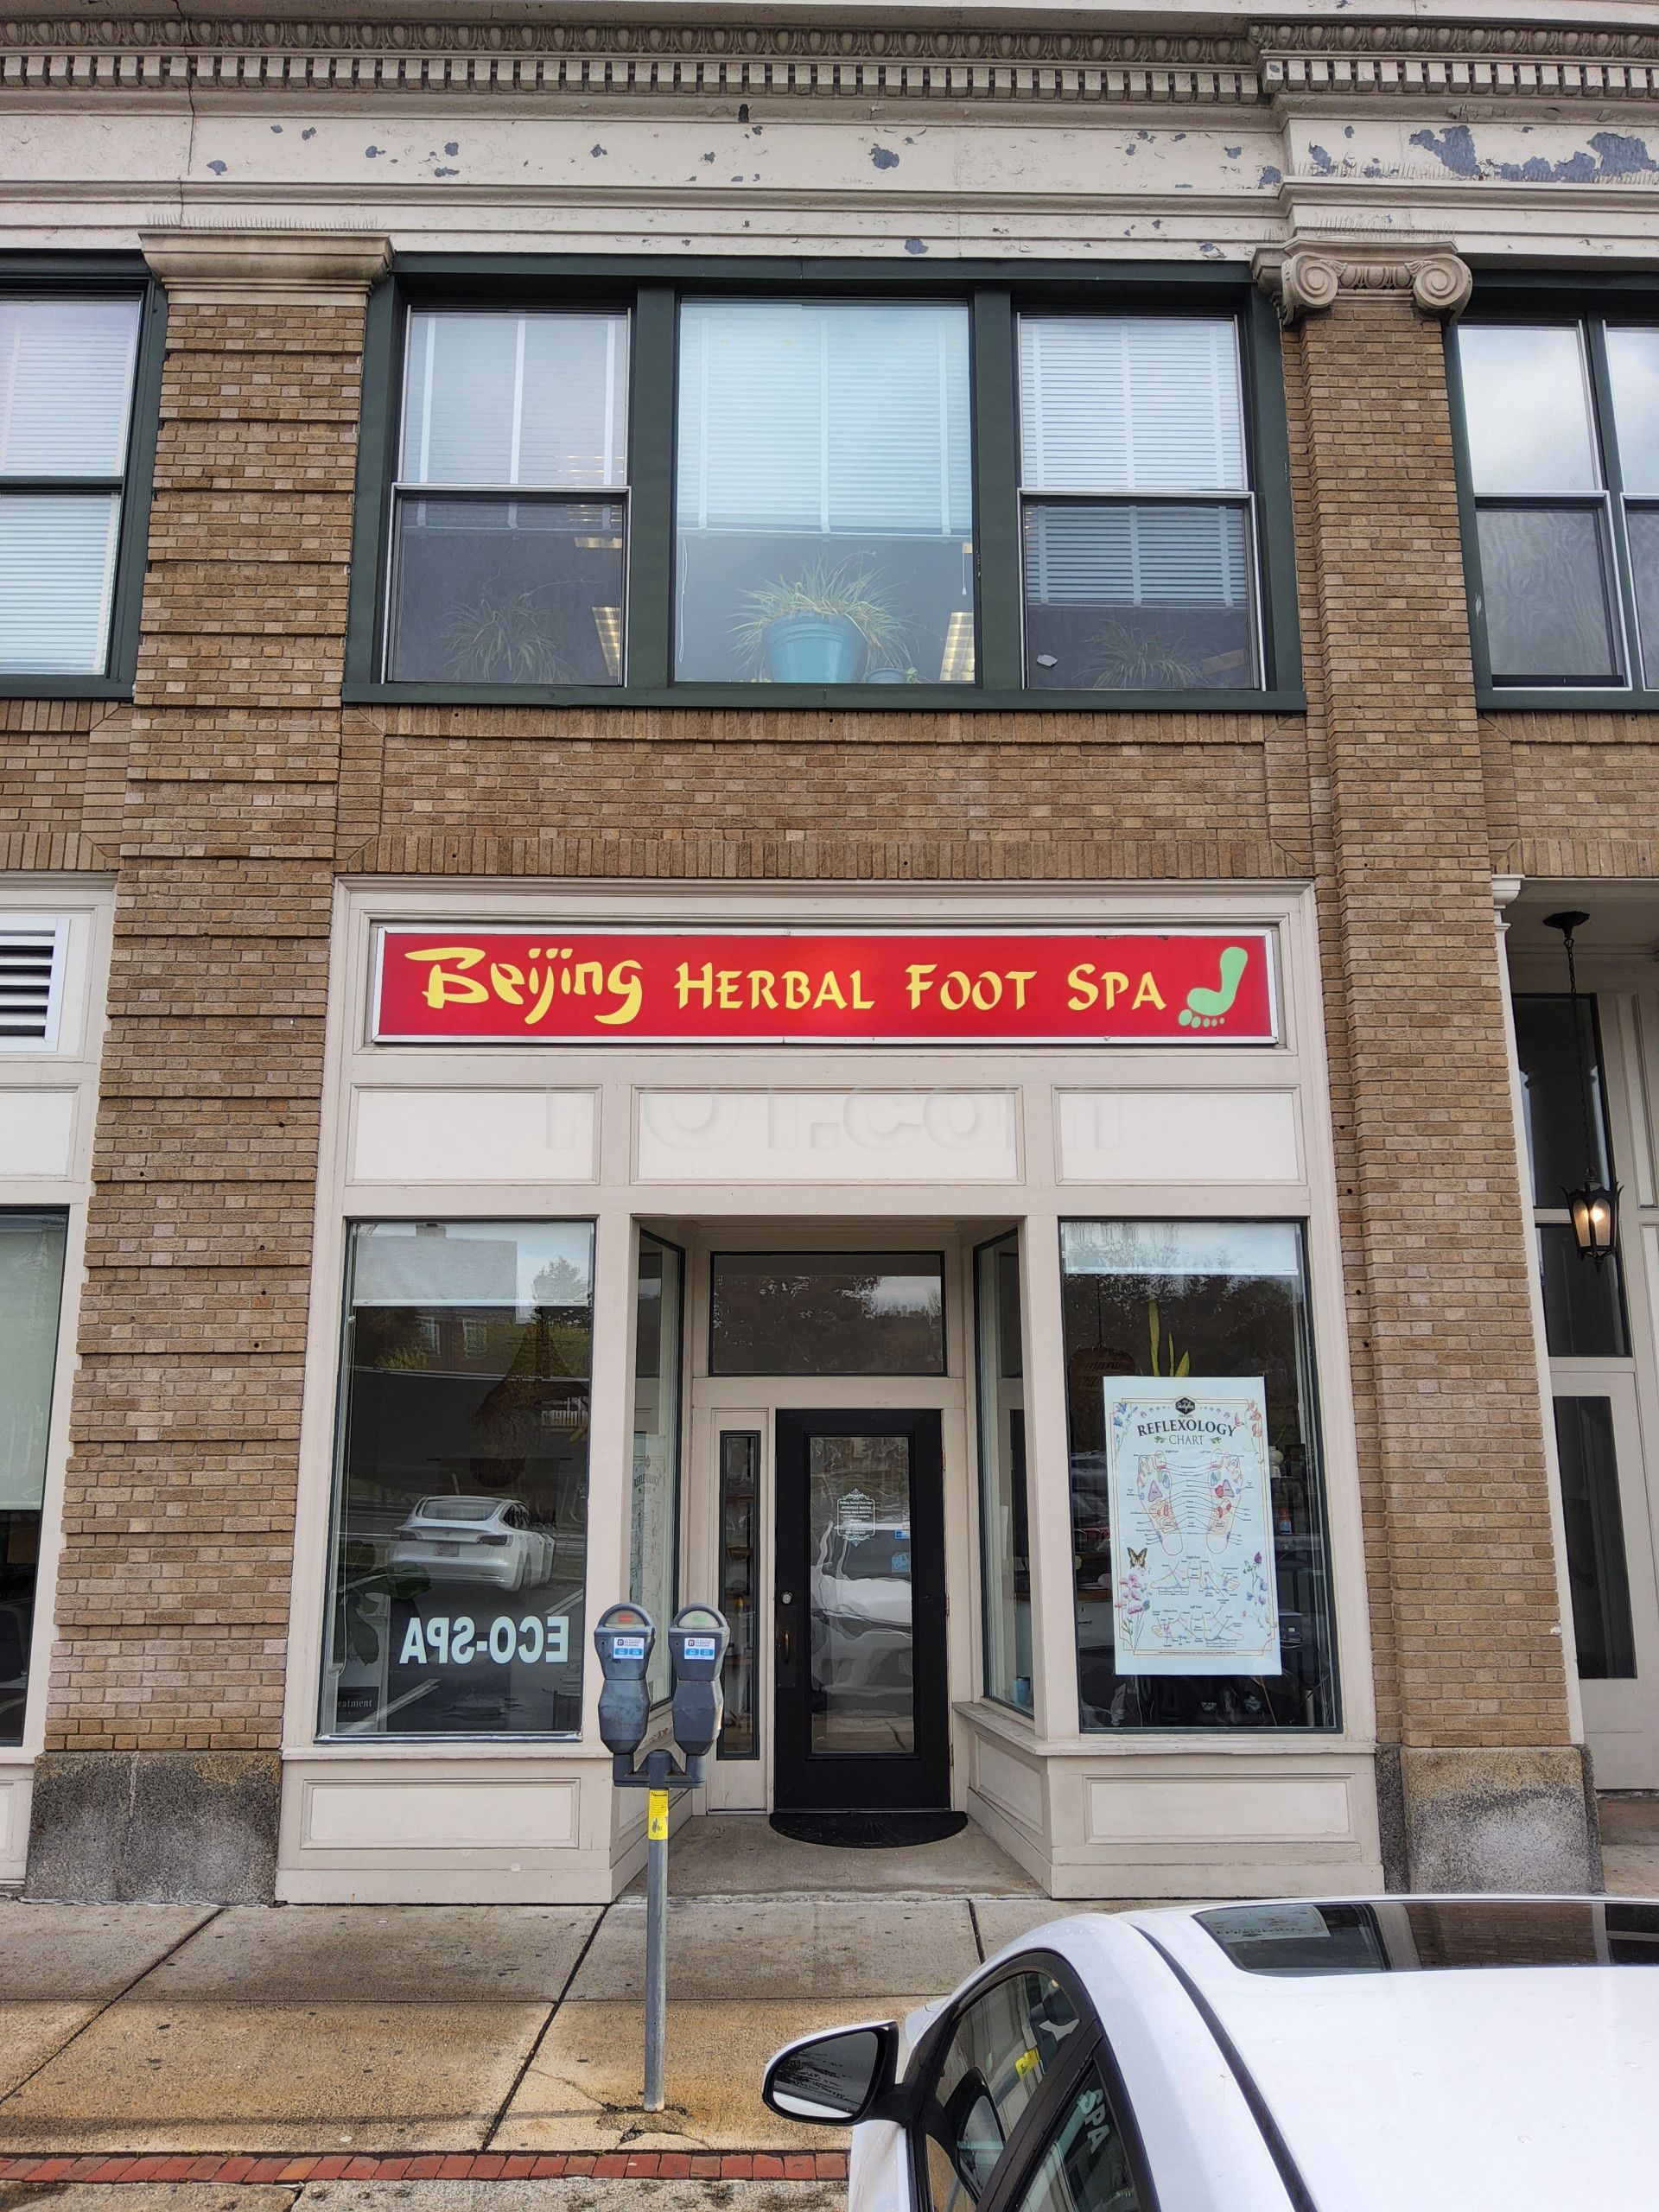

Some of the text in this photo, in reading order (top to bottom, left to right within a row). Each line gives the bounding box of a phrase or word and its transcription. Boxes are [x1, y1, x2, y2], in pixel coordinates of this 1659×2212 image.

[404, 946, 1167, 1025] Beijing HERBAL FOOT SPA
[1137, 1419, 1236, 1437] REFLEXOLOGY
[1168, 1434, 1205, 1446] CHART
